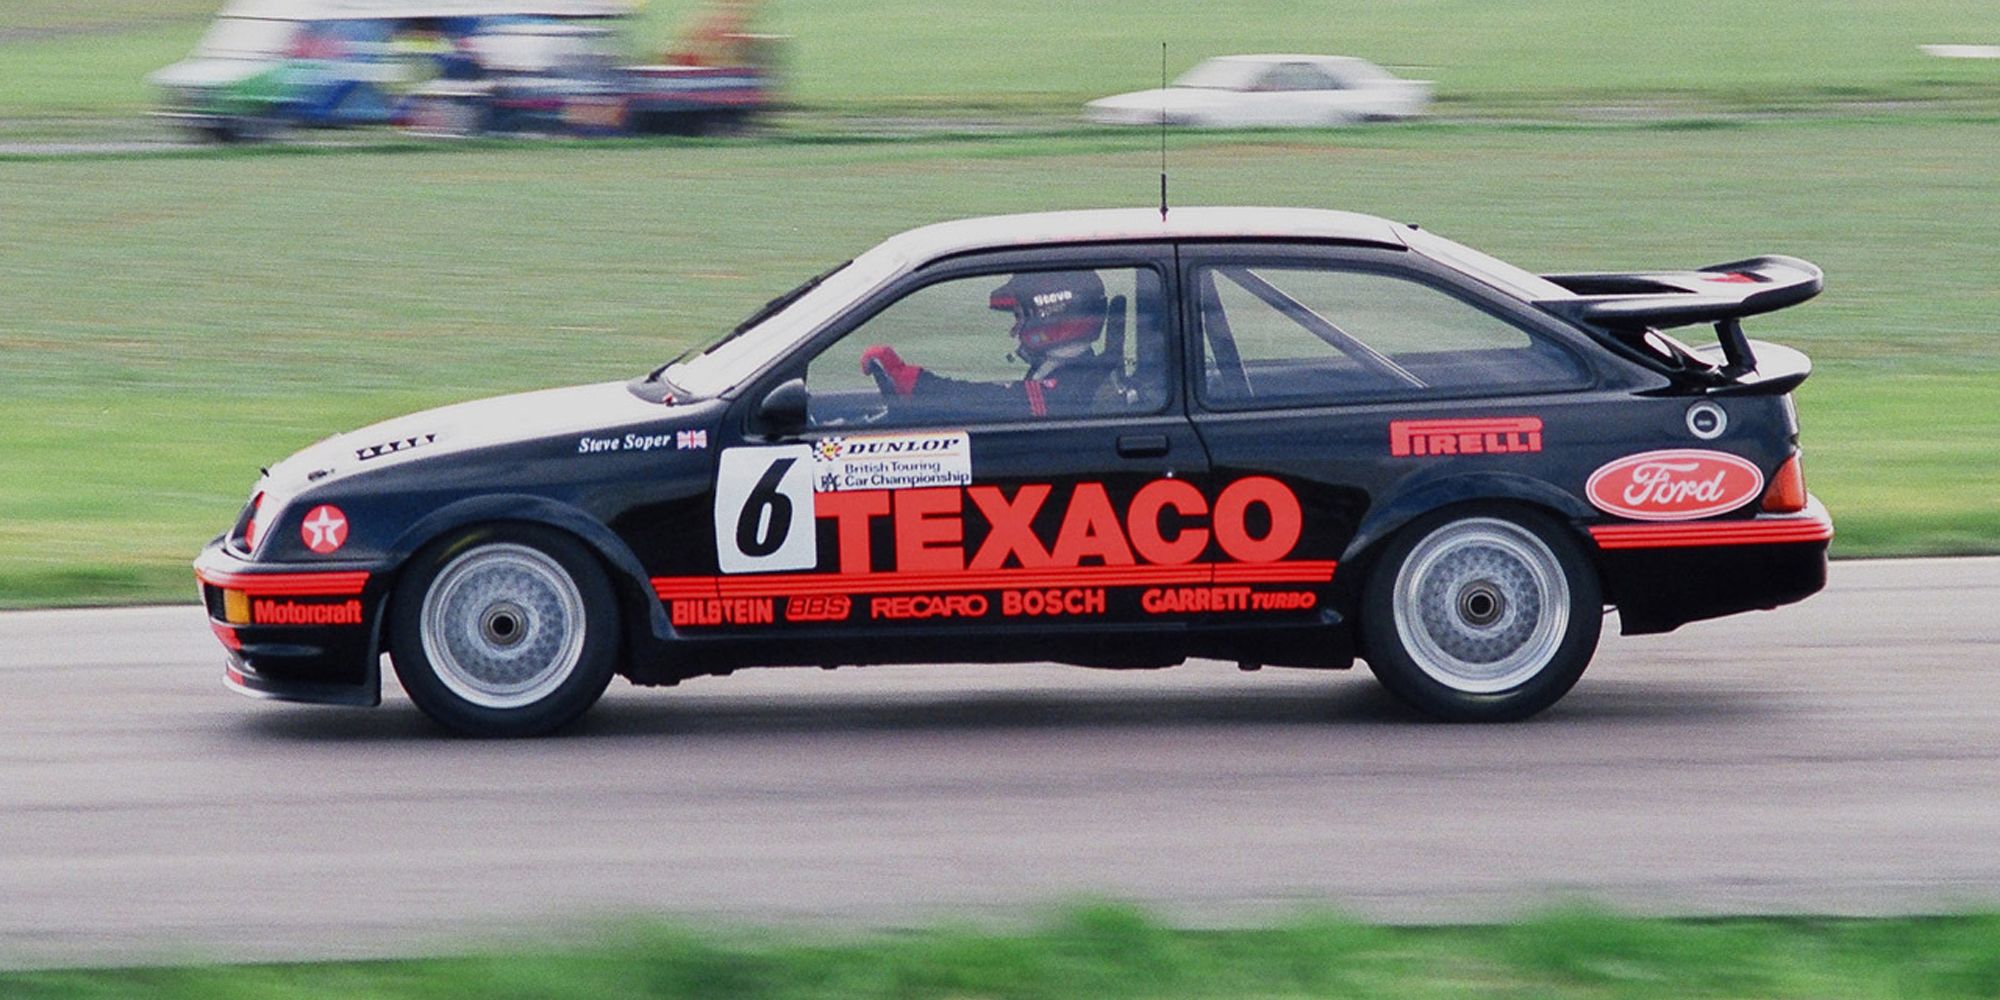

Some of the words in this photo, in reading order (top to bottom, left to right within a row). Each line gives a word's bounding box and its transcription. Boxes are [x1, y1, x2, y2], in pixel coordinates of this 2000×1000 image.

[578, 437, 620, 453] Steve
[623, 433, 671, 451] Soper
[847, 438, 960, 455] DUNLOP
[1389, 416, 1543, 457] PIRELLI
[844, 461, 889, 474] British
[890, 460, 942, 473] Touring
[844, 475, 868, 487] Car
[870, 470, 970, 488] Championship
[1623, 461, 1726, 506] Ford
[736, 457, 798, 557] 6
[815, 475, 1303, 575] TEXACO
[254, 599, 363, 625] Motorcraft
[672, 598, 774, 626] BILSTEIN
[786, 596, 850, 621] BBS
[870, 594, 988, 619] RECARO
[1002, 588, 1107, 616] BOSCH
[1142, 586, 1251, 614] GARRETT
[1251, 591, 1317, 611] TURBO
